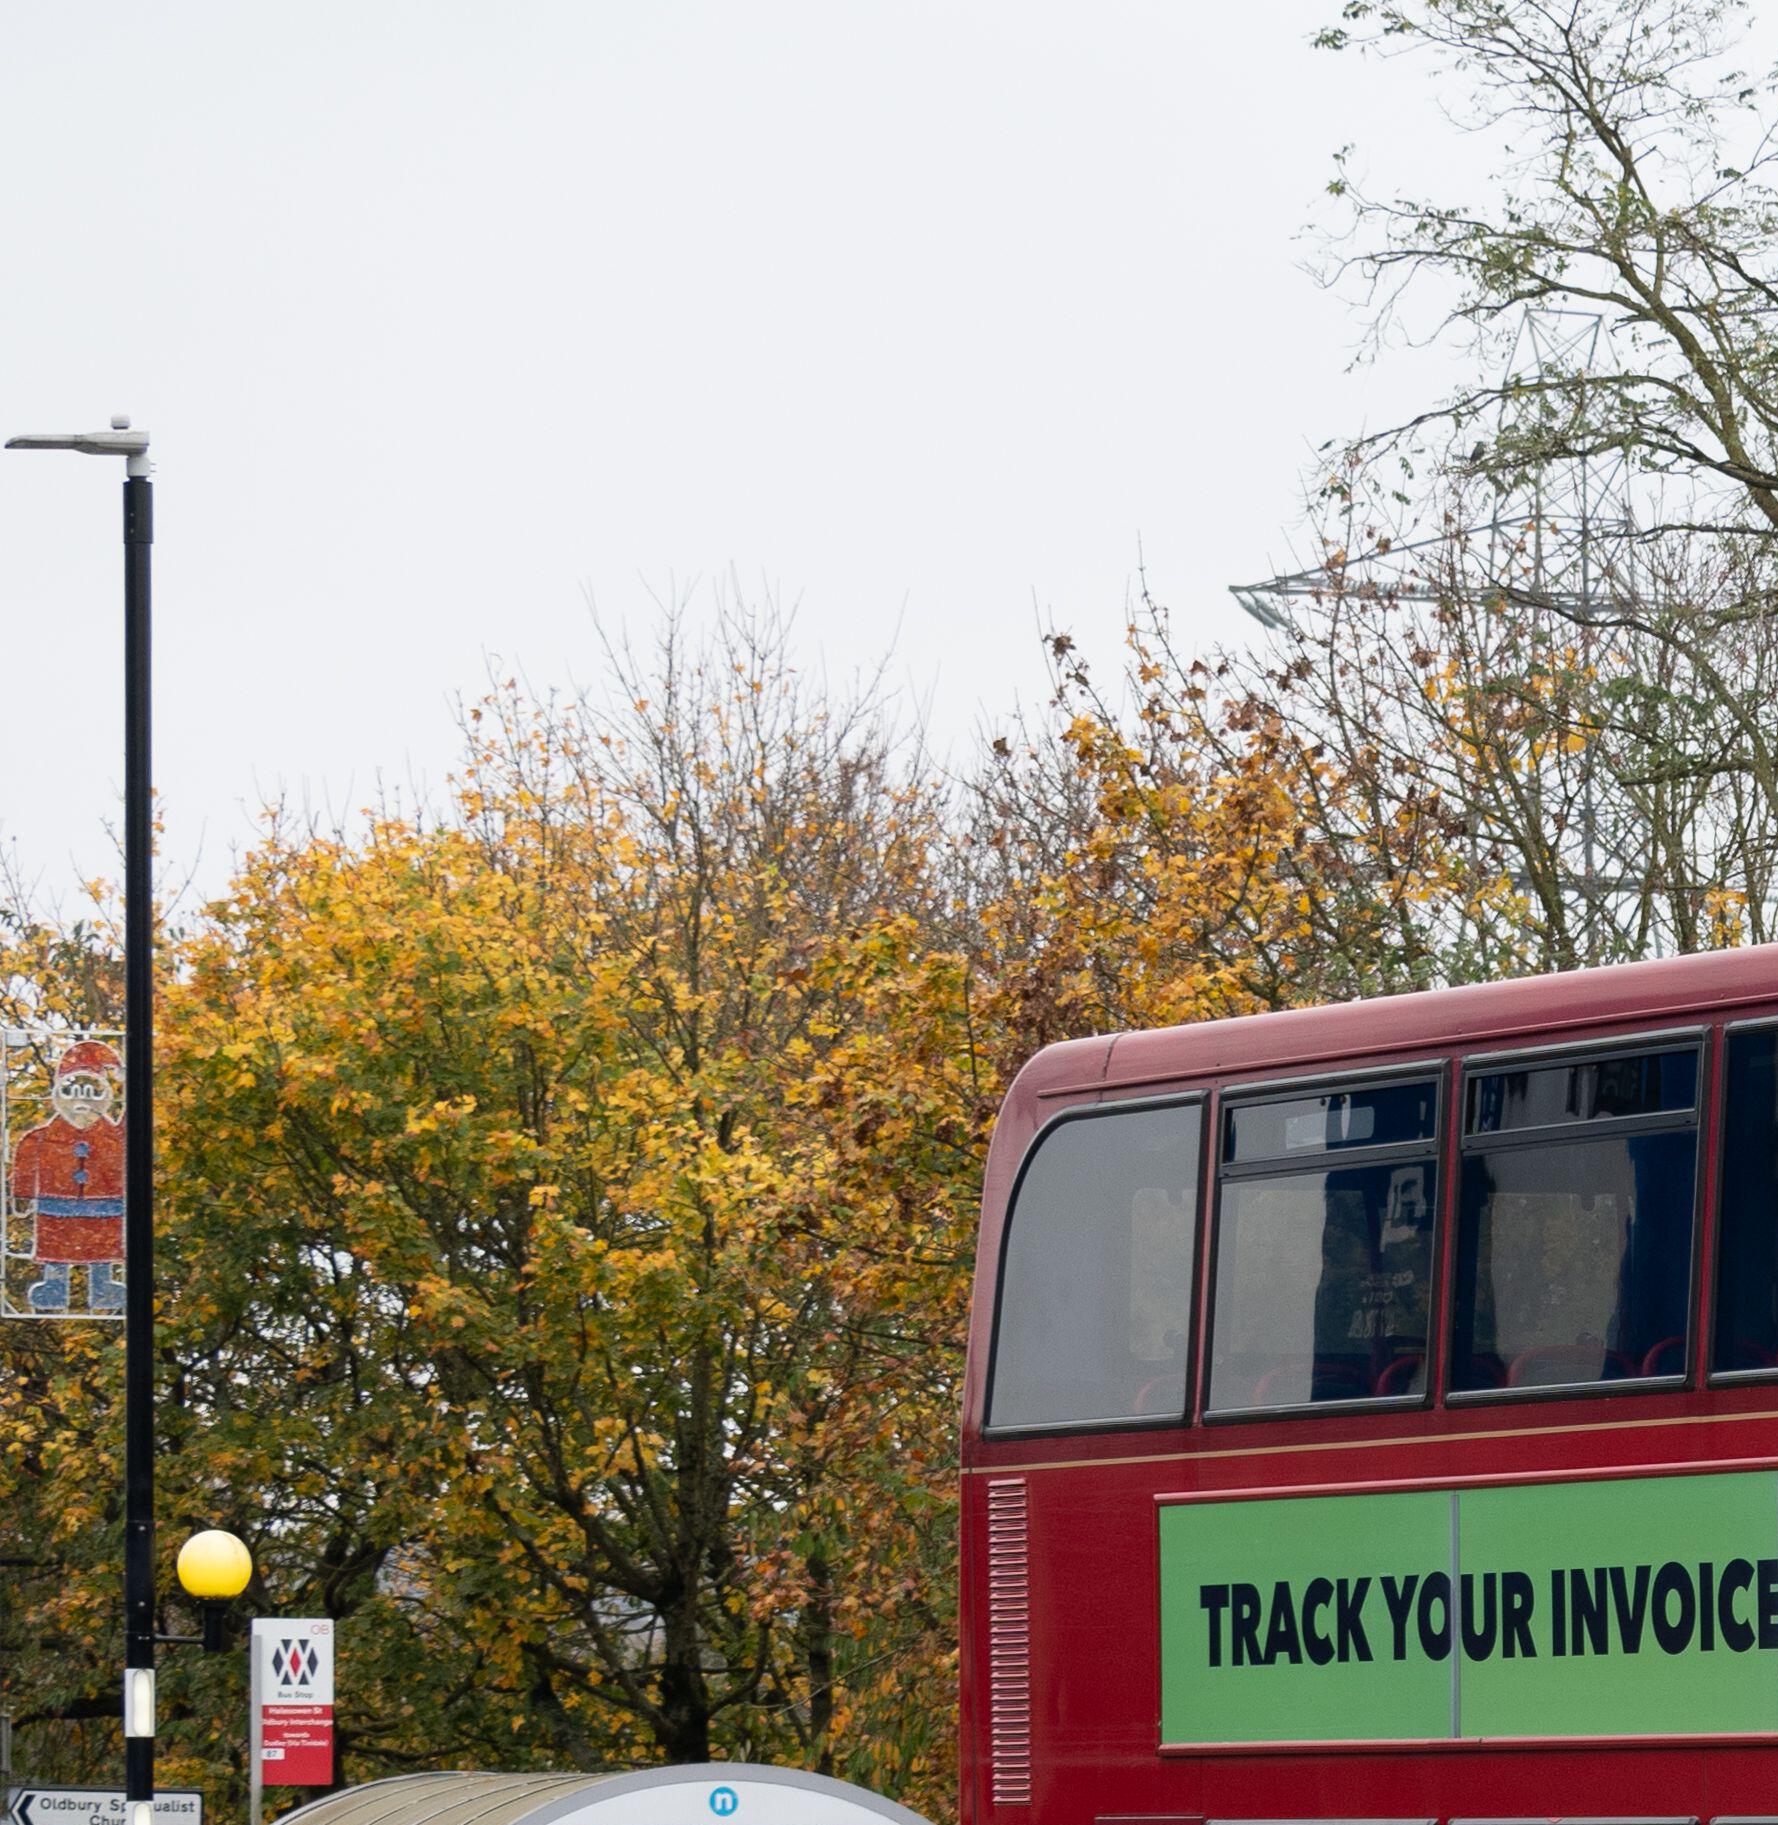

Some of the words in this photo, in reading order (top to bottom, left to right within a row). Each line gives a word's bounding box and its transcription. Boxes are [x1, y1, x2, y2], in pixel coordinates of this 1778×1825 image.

[1200, 1576, 1374, 1667] TRACK
[1379, 1570, 1537, 1662] YOUR
[40, 1797, 102, 1813] Oldbury
[110, 1798, 195, 1813] Spualist
